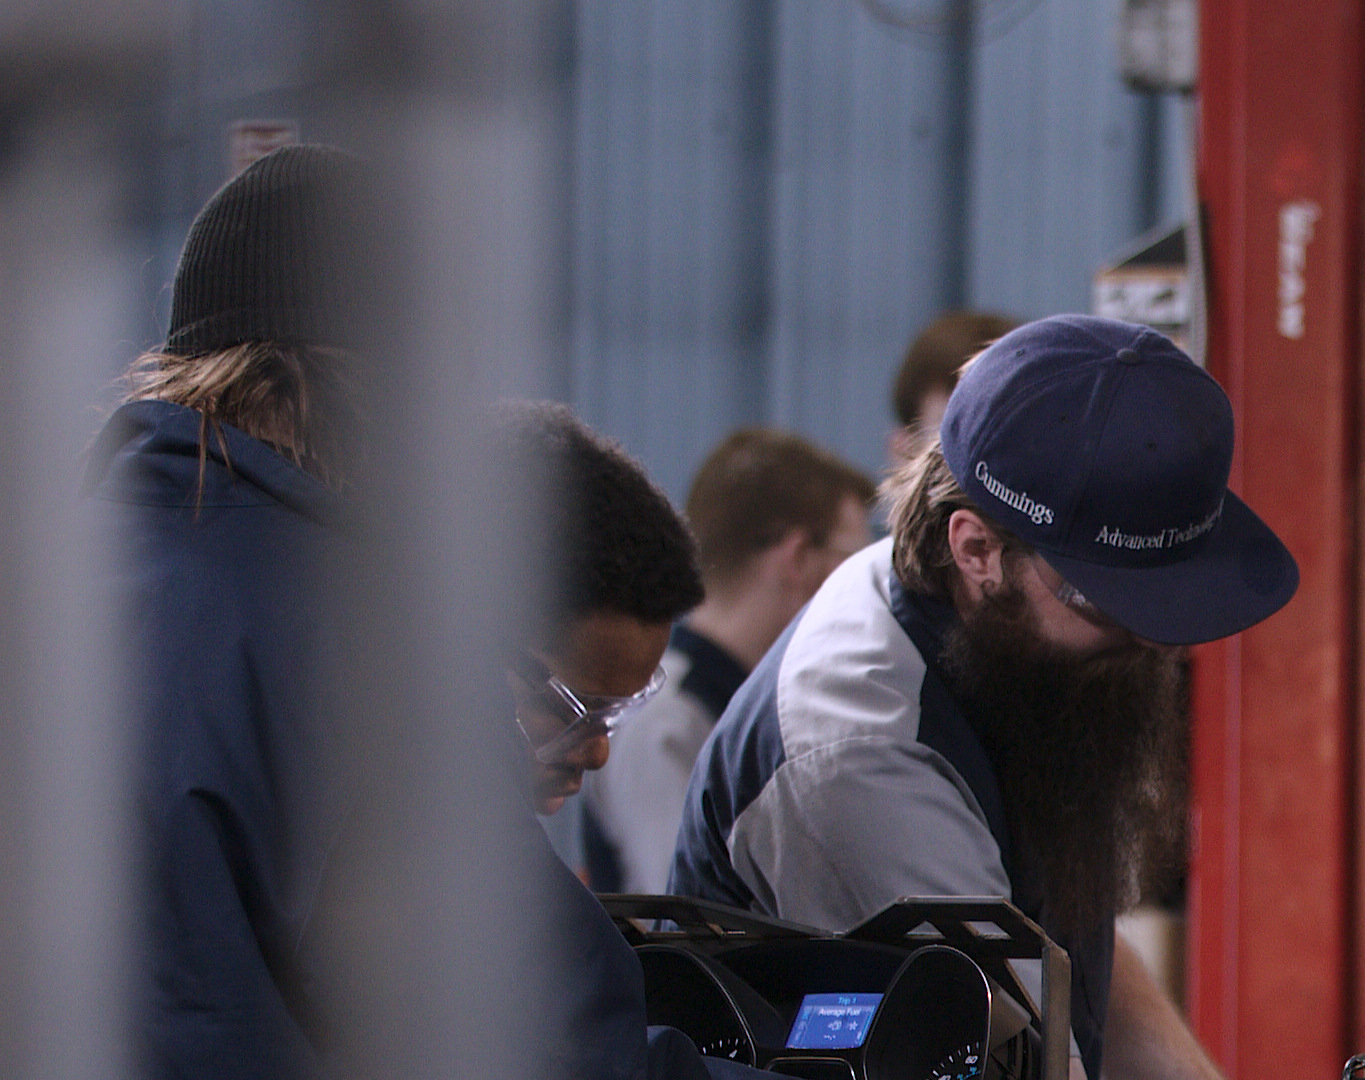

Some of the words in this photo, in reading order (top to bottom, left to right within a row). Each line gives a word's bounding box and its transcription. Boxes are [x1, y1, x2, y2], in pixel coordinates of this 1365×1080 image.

[975, 461, 1054, 524] Cummings
[1095, 525, 1166, 550] Advanced
[818, 1007, 846, 1018] Average
[846, 1007, 862, 1016] Fuel
